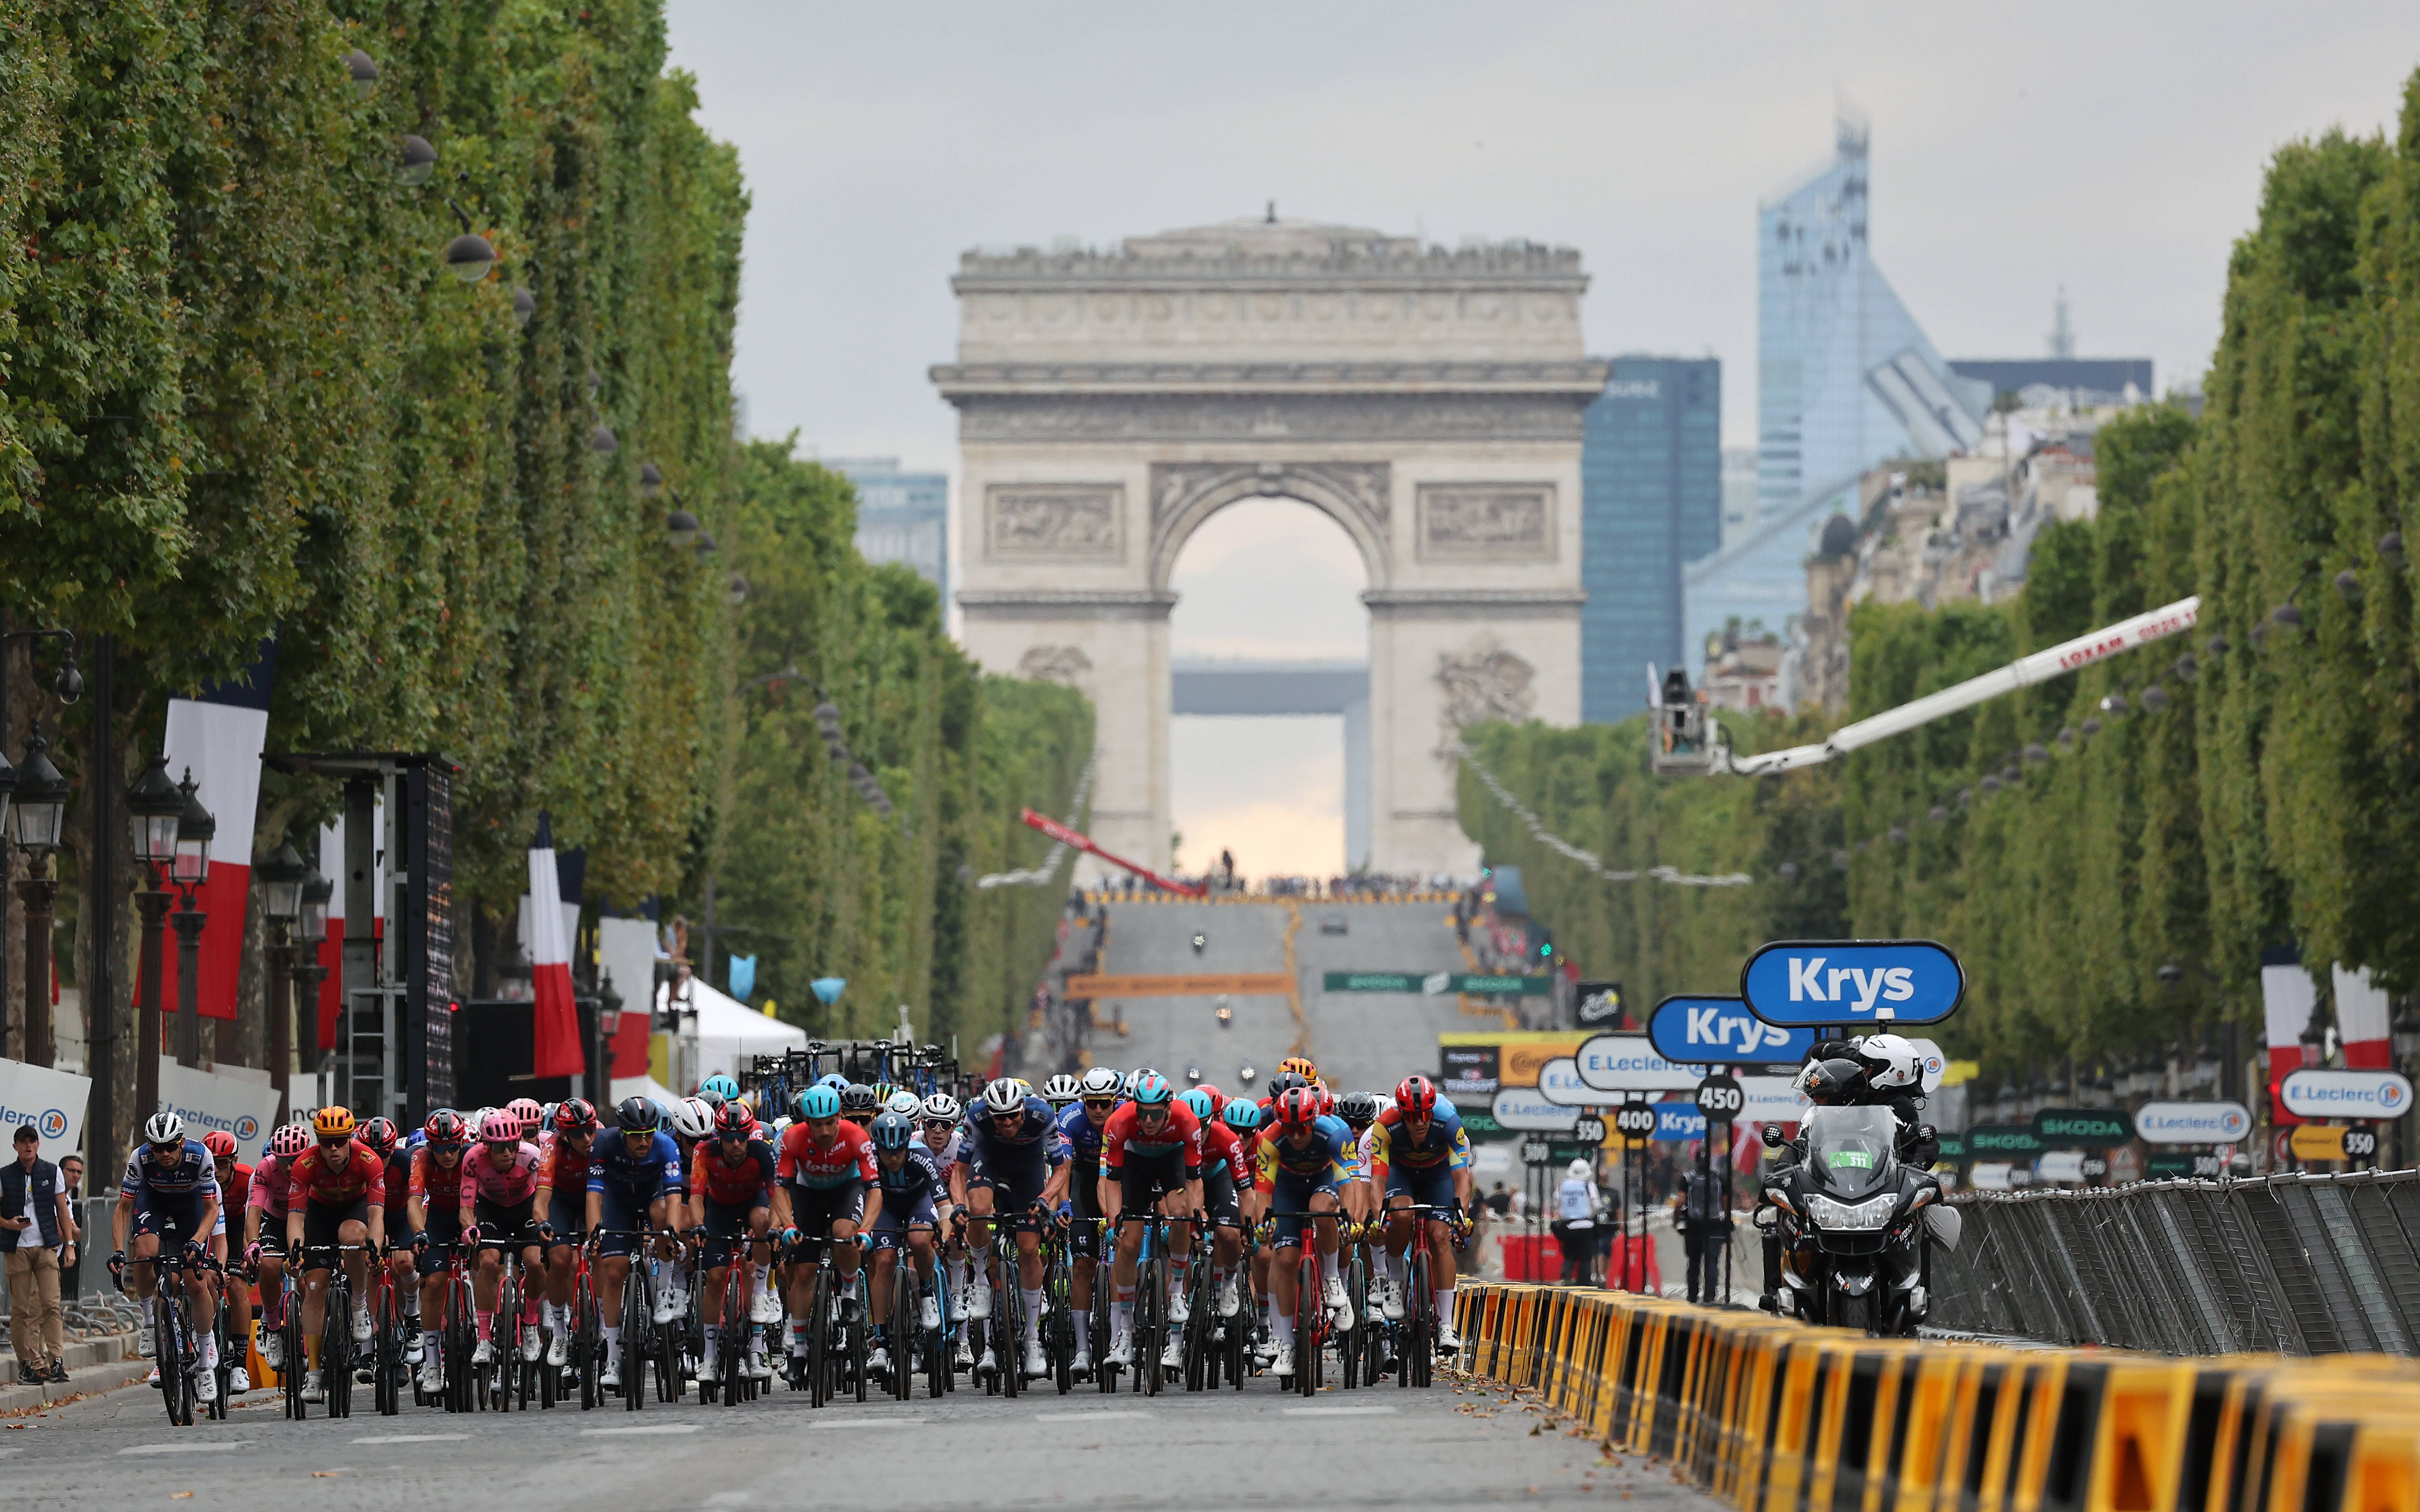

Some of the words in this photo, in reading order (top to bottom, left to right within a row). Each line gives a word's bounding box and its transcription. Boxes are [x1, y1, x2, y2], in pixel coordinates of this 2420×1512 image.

[1789, 958, 1914, 1012] Krys
[1687, 1008, 1791, 1054] Krys
[1698, 1087, 1742, 1110] 450
[2291, 1085, 2374, 1102] E.Leclerc
[1577, 1120, 1604, 1141] 350
[1617, 1110, 1654, 1130] 400
[1661, 1113, 1707, 1134] Krys
[2144, 1115, 2218, 1129] E.Leclerc
[908, 1151, 939, 1181] youfone
[1230, 1140, 1244, 1171] lotto
[1850, 1156, 1866, 1168] 311
[805, 1160, 847, 1173] lotto
